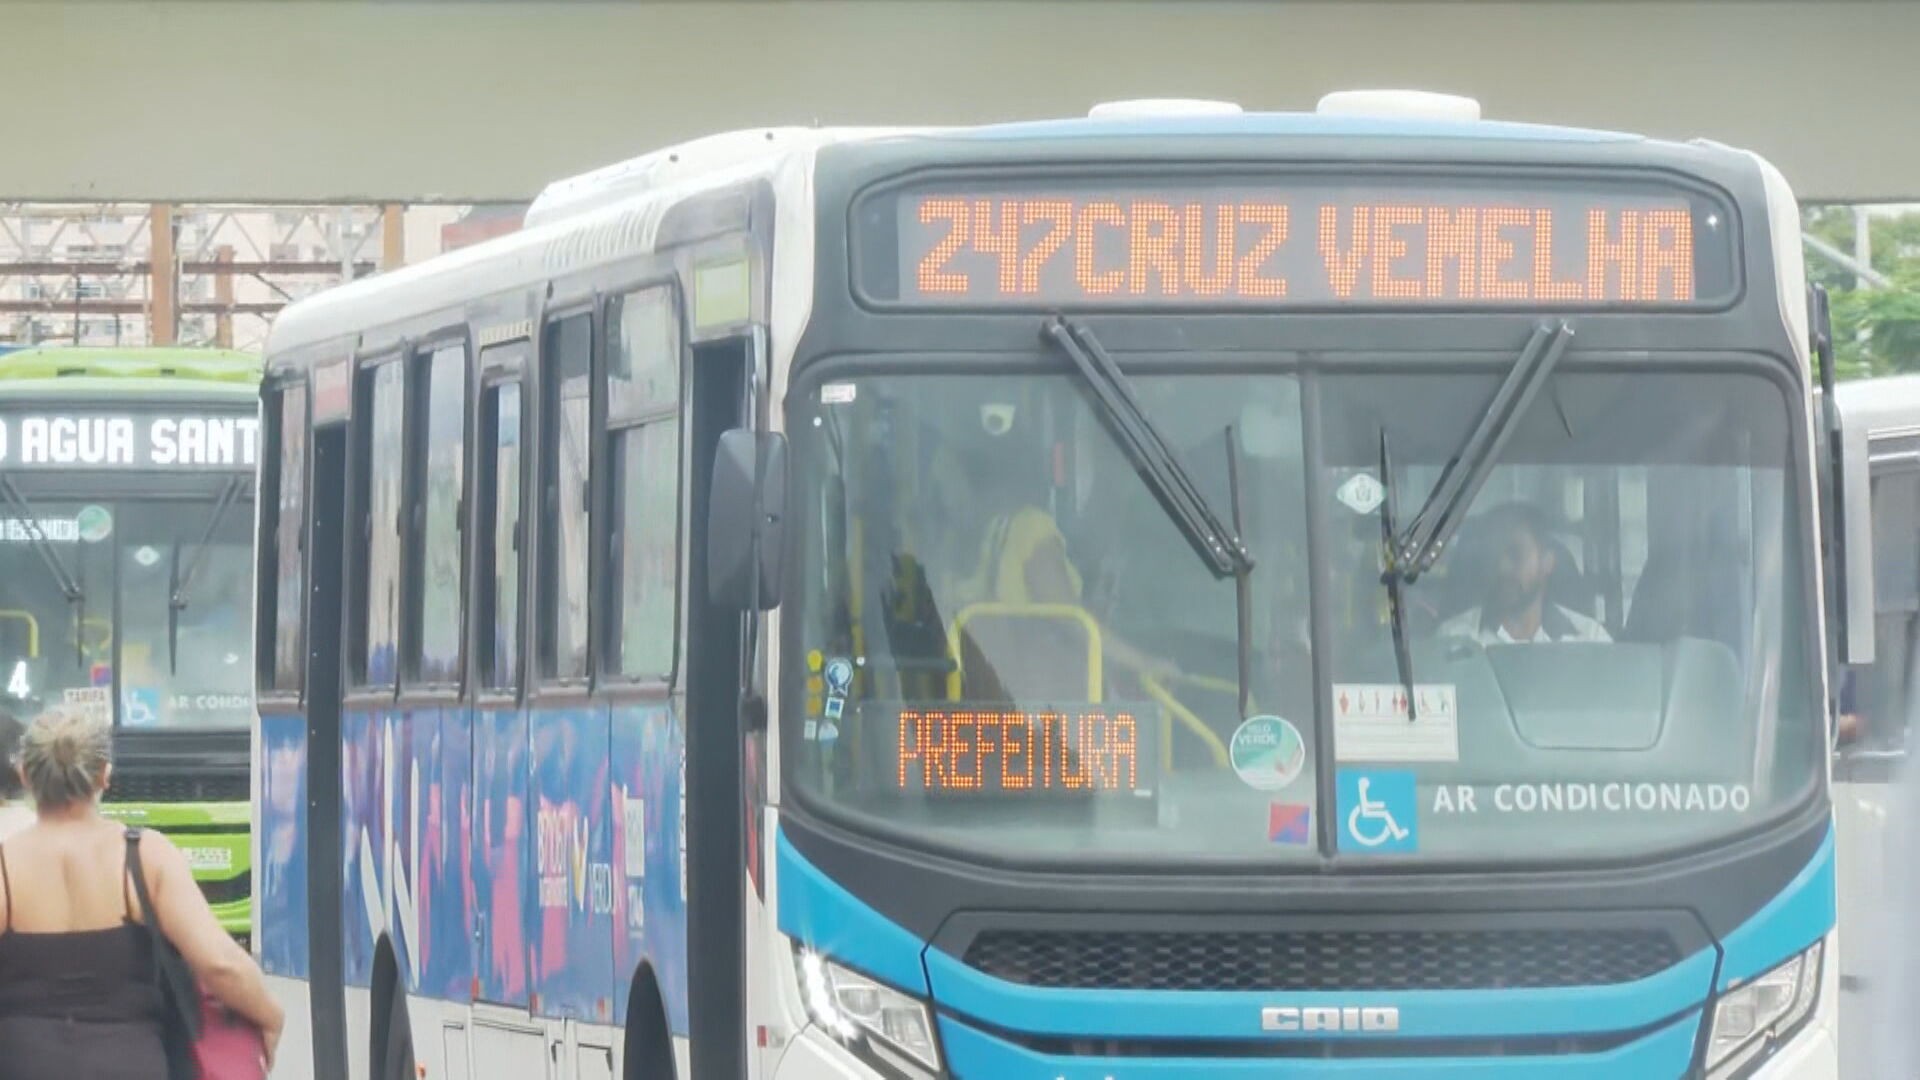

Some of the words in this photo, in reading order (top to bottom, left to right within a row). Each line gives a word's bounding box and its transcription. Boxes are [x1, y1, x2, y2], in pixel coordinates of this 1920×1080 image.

[1318, 204, 1695, 301] VEMELHA
[21, 417, 135, 463] AGUA
[898, 712, 1137, 788] PREFEITURA
[1433, 785, 1478, 813] AR
[1494, 783, 1750, 812] CONDICIONADO
[1261, 1007, 1400, 1031] CAIO
